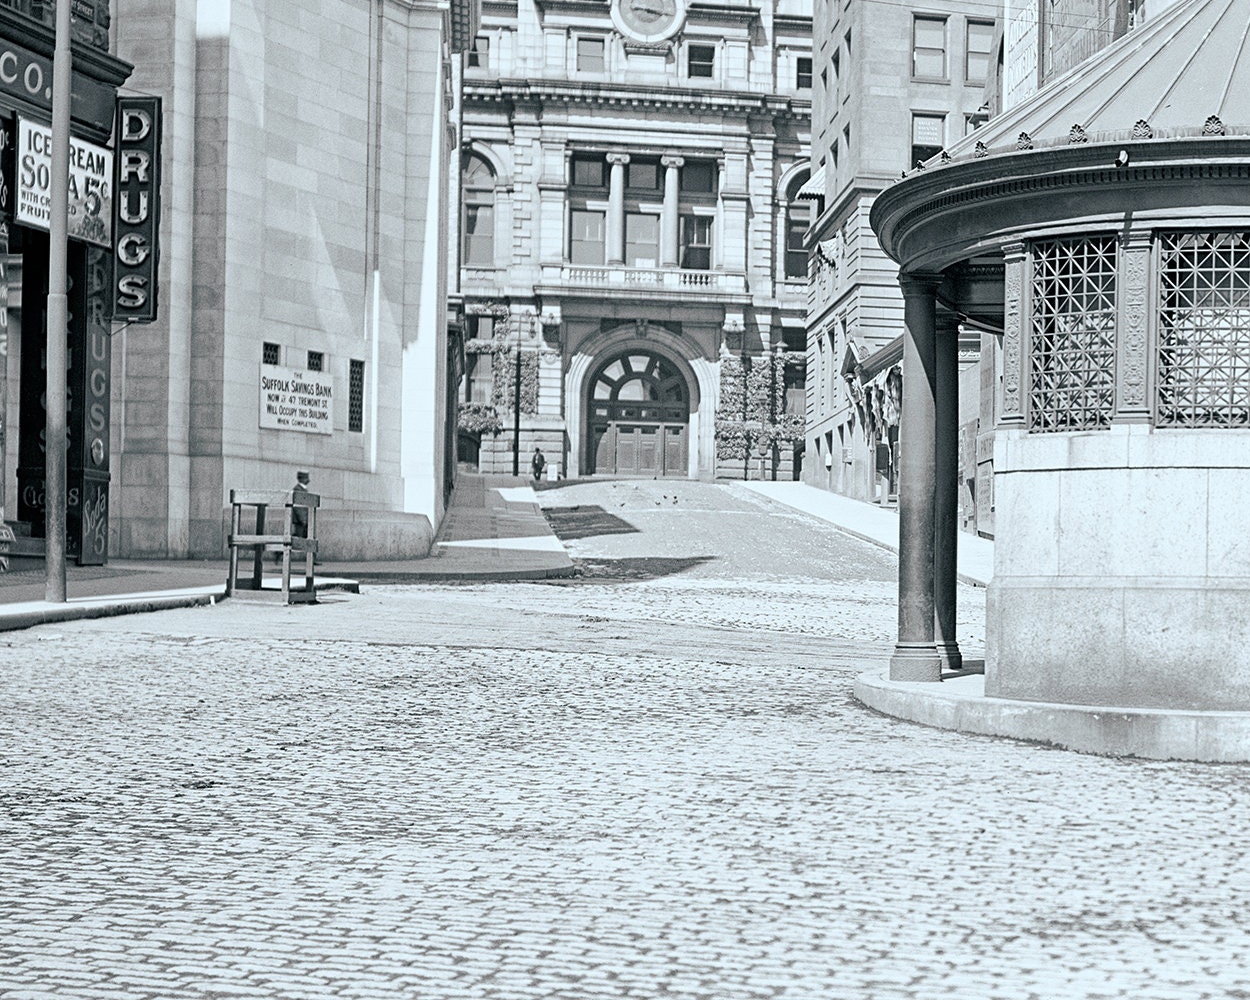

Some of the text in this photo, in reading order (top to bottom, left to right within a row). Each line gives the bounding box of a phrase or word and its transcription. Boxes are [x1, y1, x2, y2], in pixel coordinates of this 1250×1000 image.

[28, 128, 105, 176] ICE REAM
[21, 154, 79, 200] SOA
[21, 190, 39, 204] WITH
[117, 107, 152, 310] DRUGS
[293, 371, 303, 380] THE
[262, 376, 333, 398] SUFFOLK SAVINGS BANK
[267, 393, 280, 403] NOW
[288, 395, 297, 405] 47
[298, 396, 321, 408] TREMONT
[265, 403, 329, 420] WILL OCCUPY THIS BUILDING
[277, 417, 290, 425] WHEN
